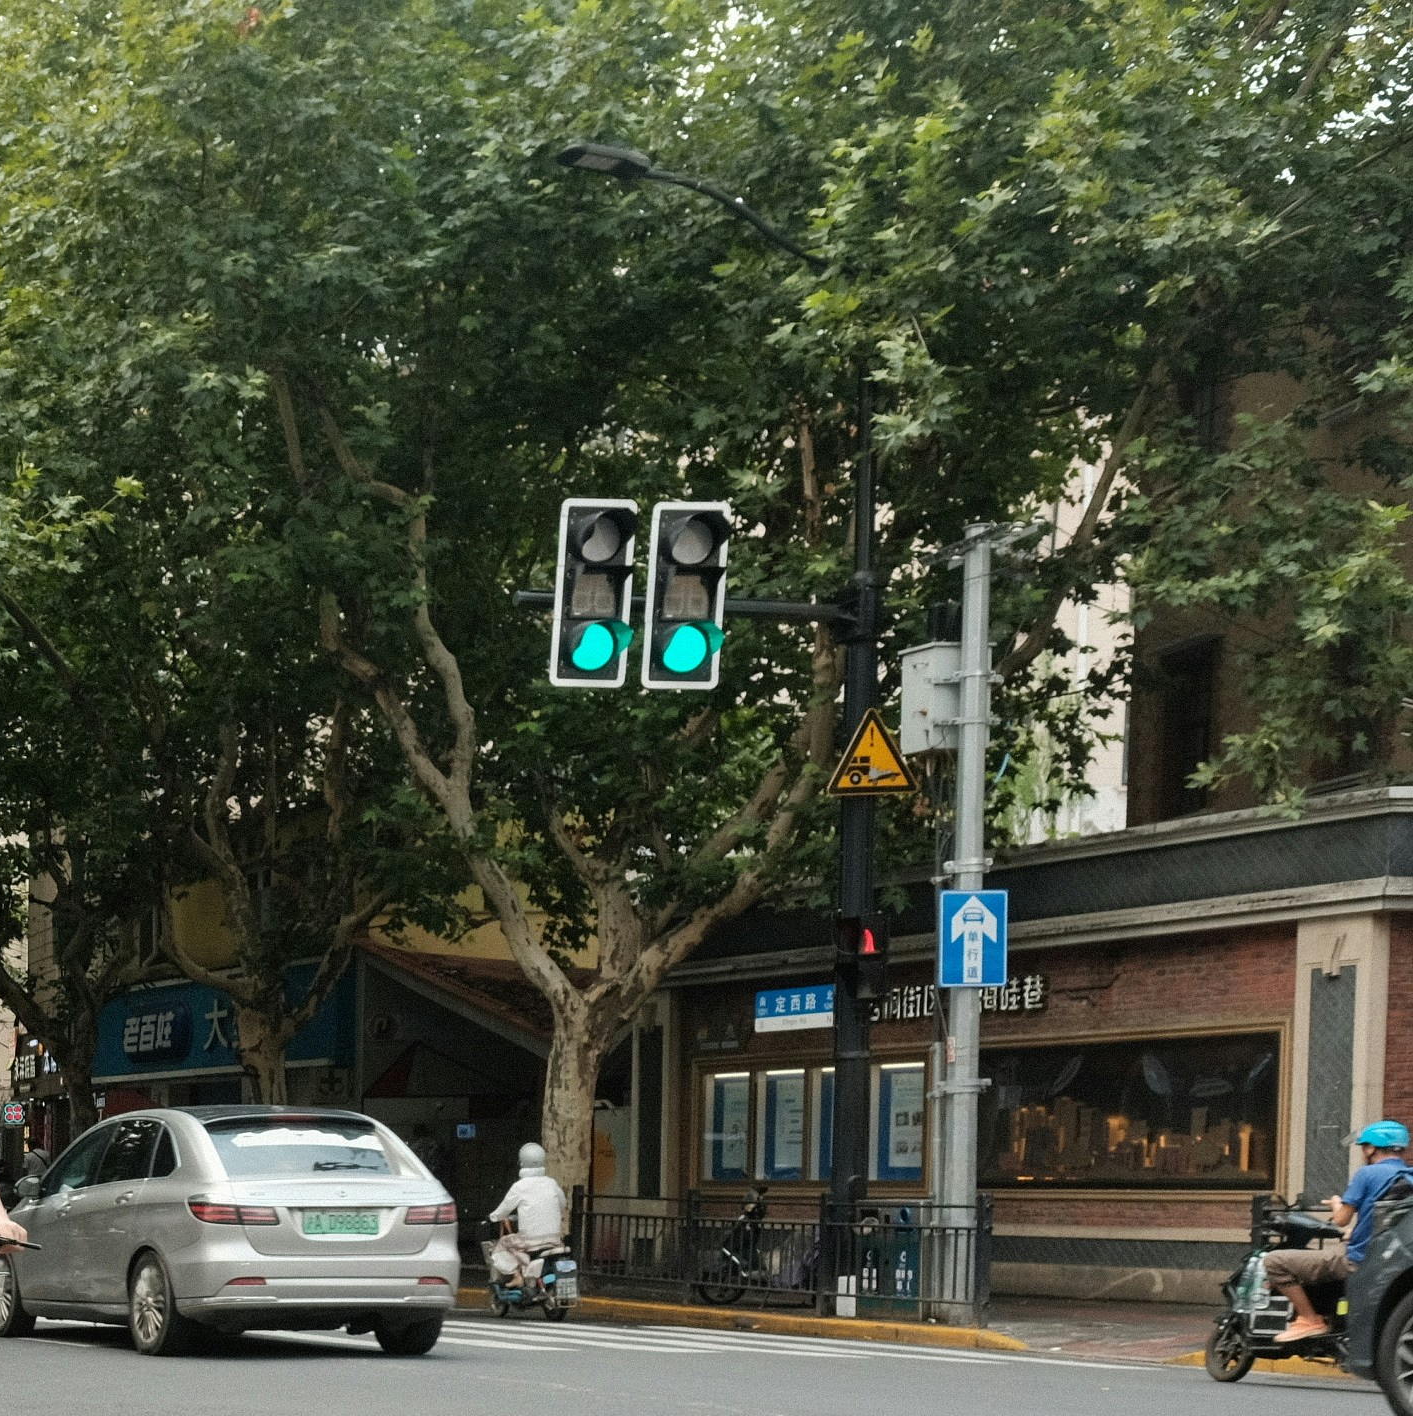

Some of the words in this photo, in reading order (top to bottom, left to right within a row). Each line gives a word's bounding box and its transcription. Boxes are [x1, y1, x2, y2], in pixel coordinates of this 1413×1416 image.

[967, 931, 979, 979] 单行道
[775, 993, 817, 1013] 定西路
[123, 1011, 175, 1053] 老百姓
